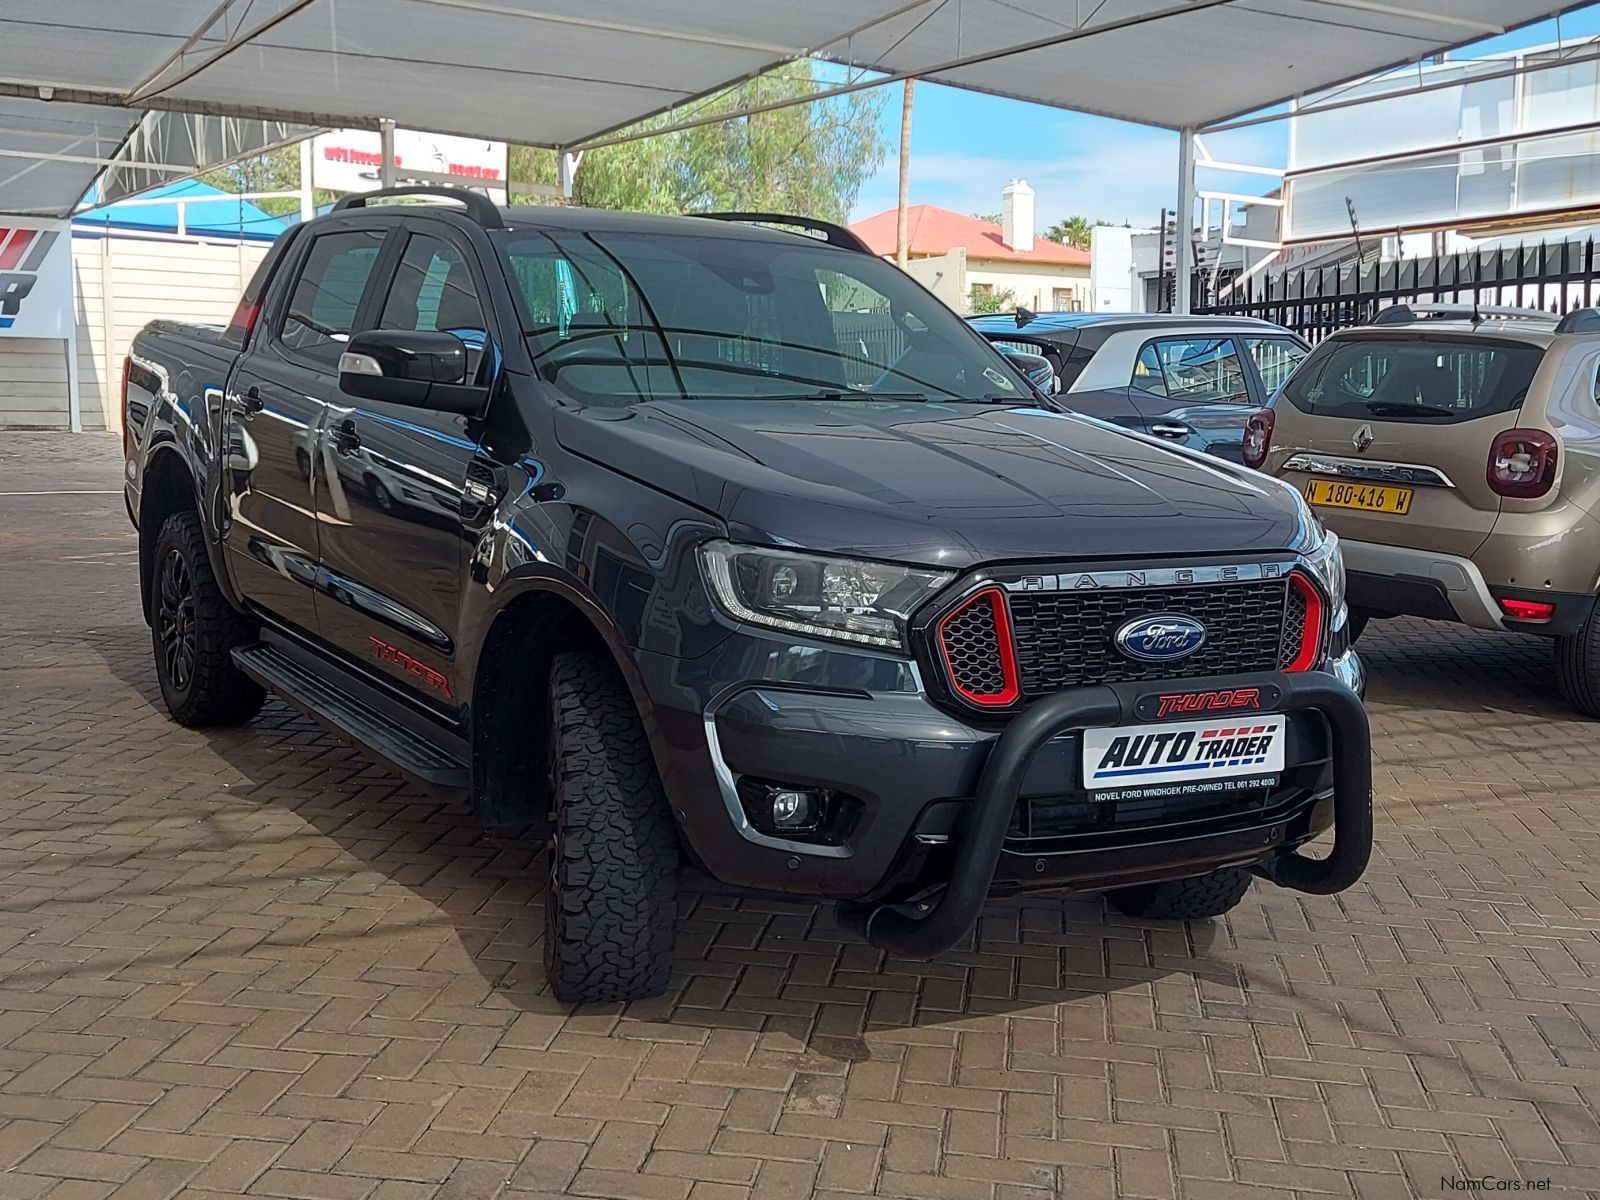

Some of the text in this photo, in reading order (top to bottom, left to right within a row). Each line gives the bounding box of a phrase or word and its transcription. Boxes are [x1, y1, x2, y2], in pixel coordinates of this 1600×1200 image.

[1306, 482, 1408, 511] N 180-416 W
[1022, 564, 1281, 590] RANGER
[1142, 624, 1190, 651] Ford
[368, 635, 453, 700] THUNDER
[1157, 688, 1261, 718] THUNDER
[1097, 731, 1274, 769] AUTO TRADER
[1095, 777, 1276, 802] NOVEL FORD WINDHOEK PRE-OWNED TEL 061 292 4000
